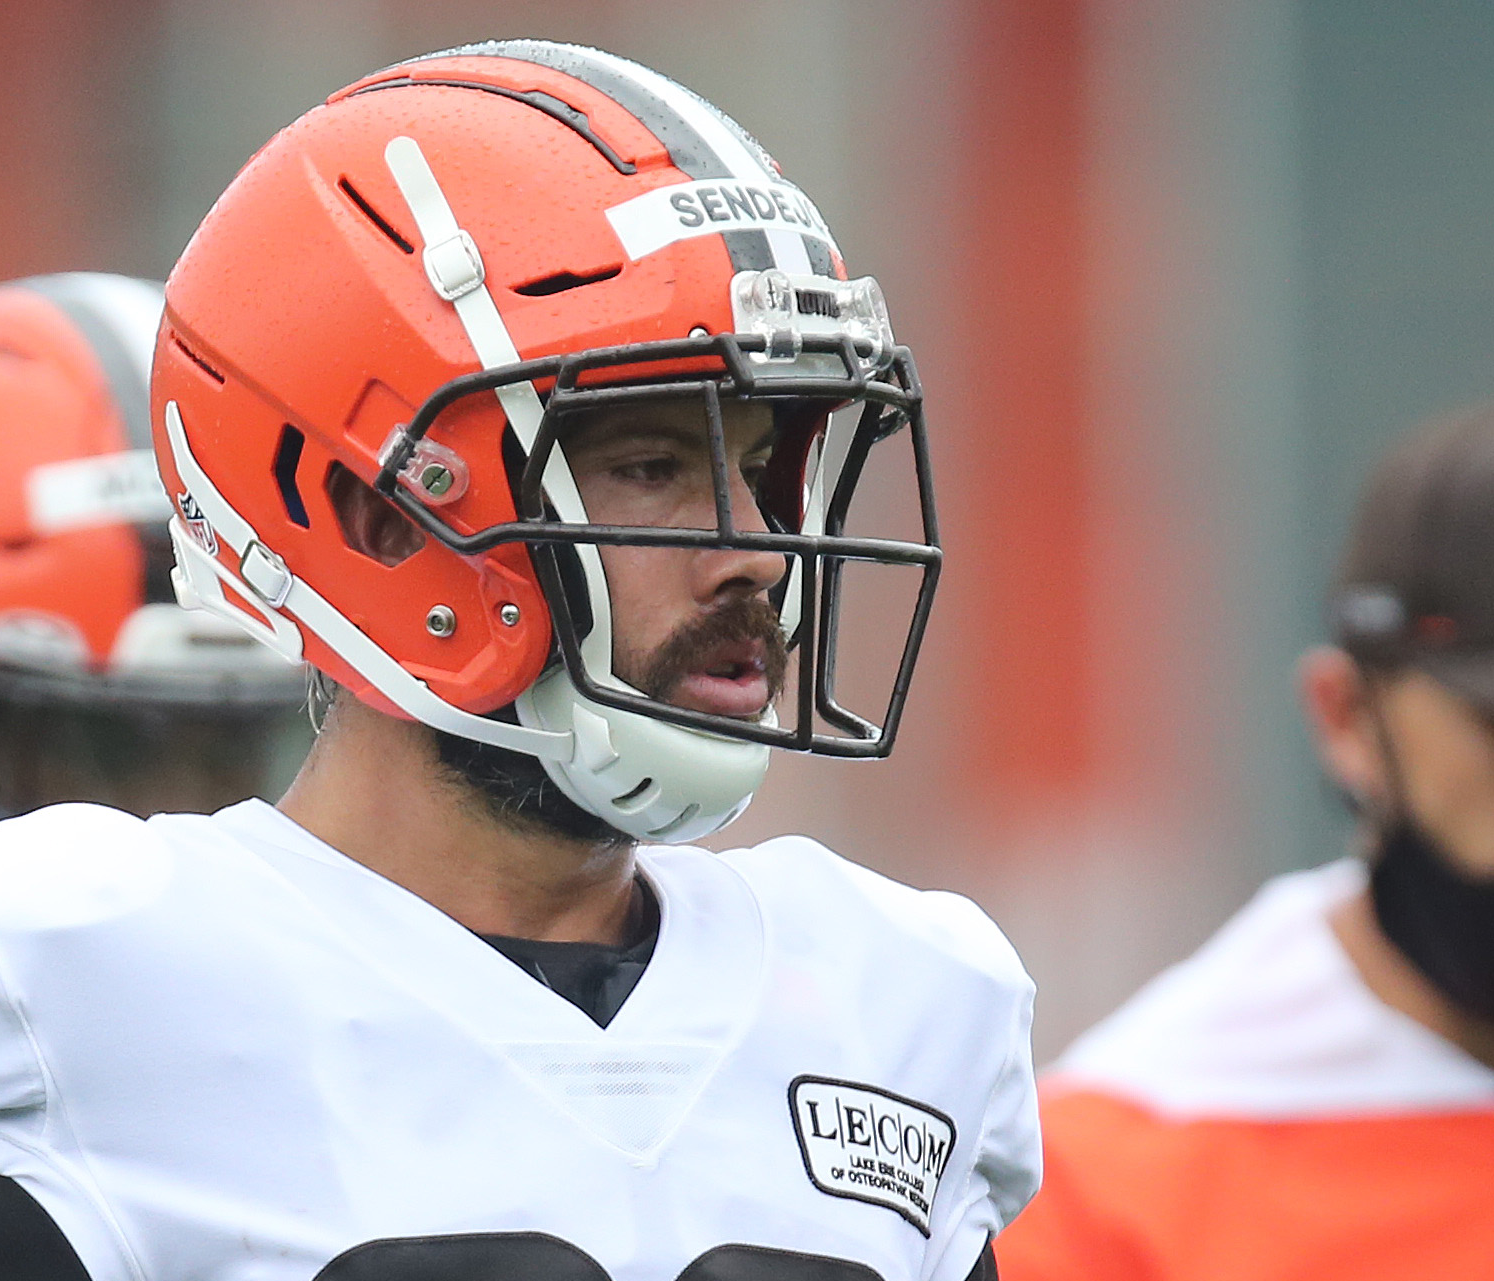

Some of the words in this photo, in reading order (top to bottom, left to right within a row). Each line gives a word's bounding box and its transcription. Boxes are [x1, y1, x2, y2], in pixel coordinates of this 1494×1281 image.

[807, 1099, 945, 1179] LECOM
[850, 1155, 876, 1172] LAKE
[831, 1167, 844, 1180] OF
